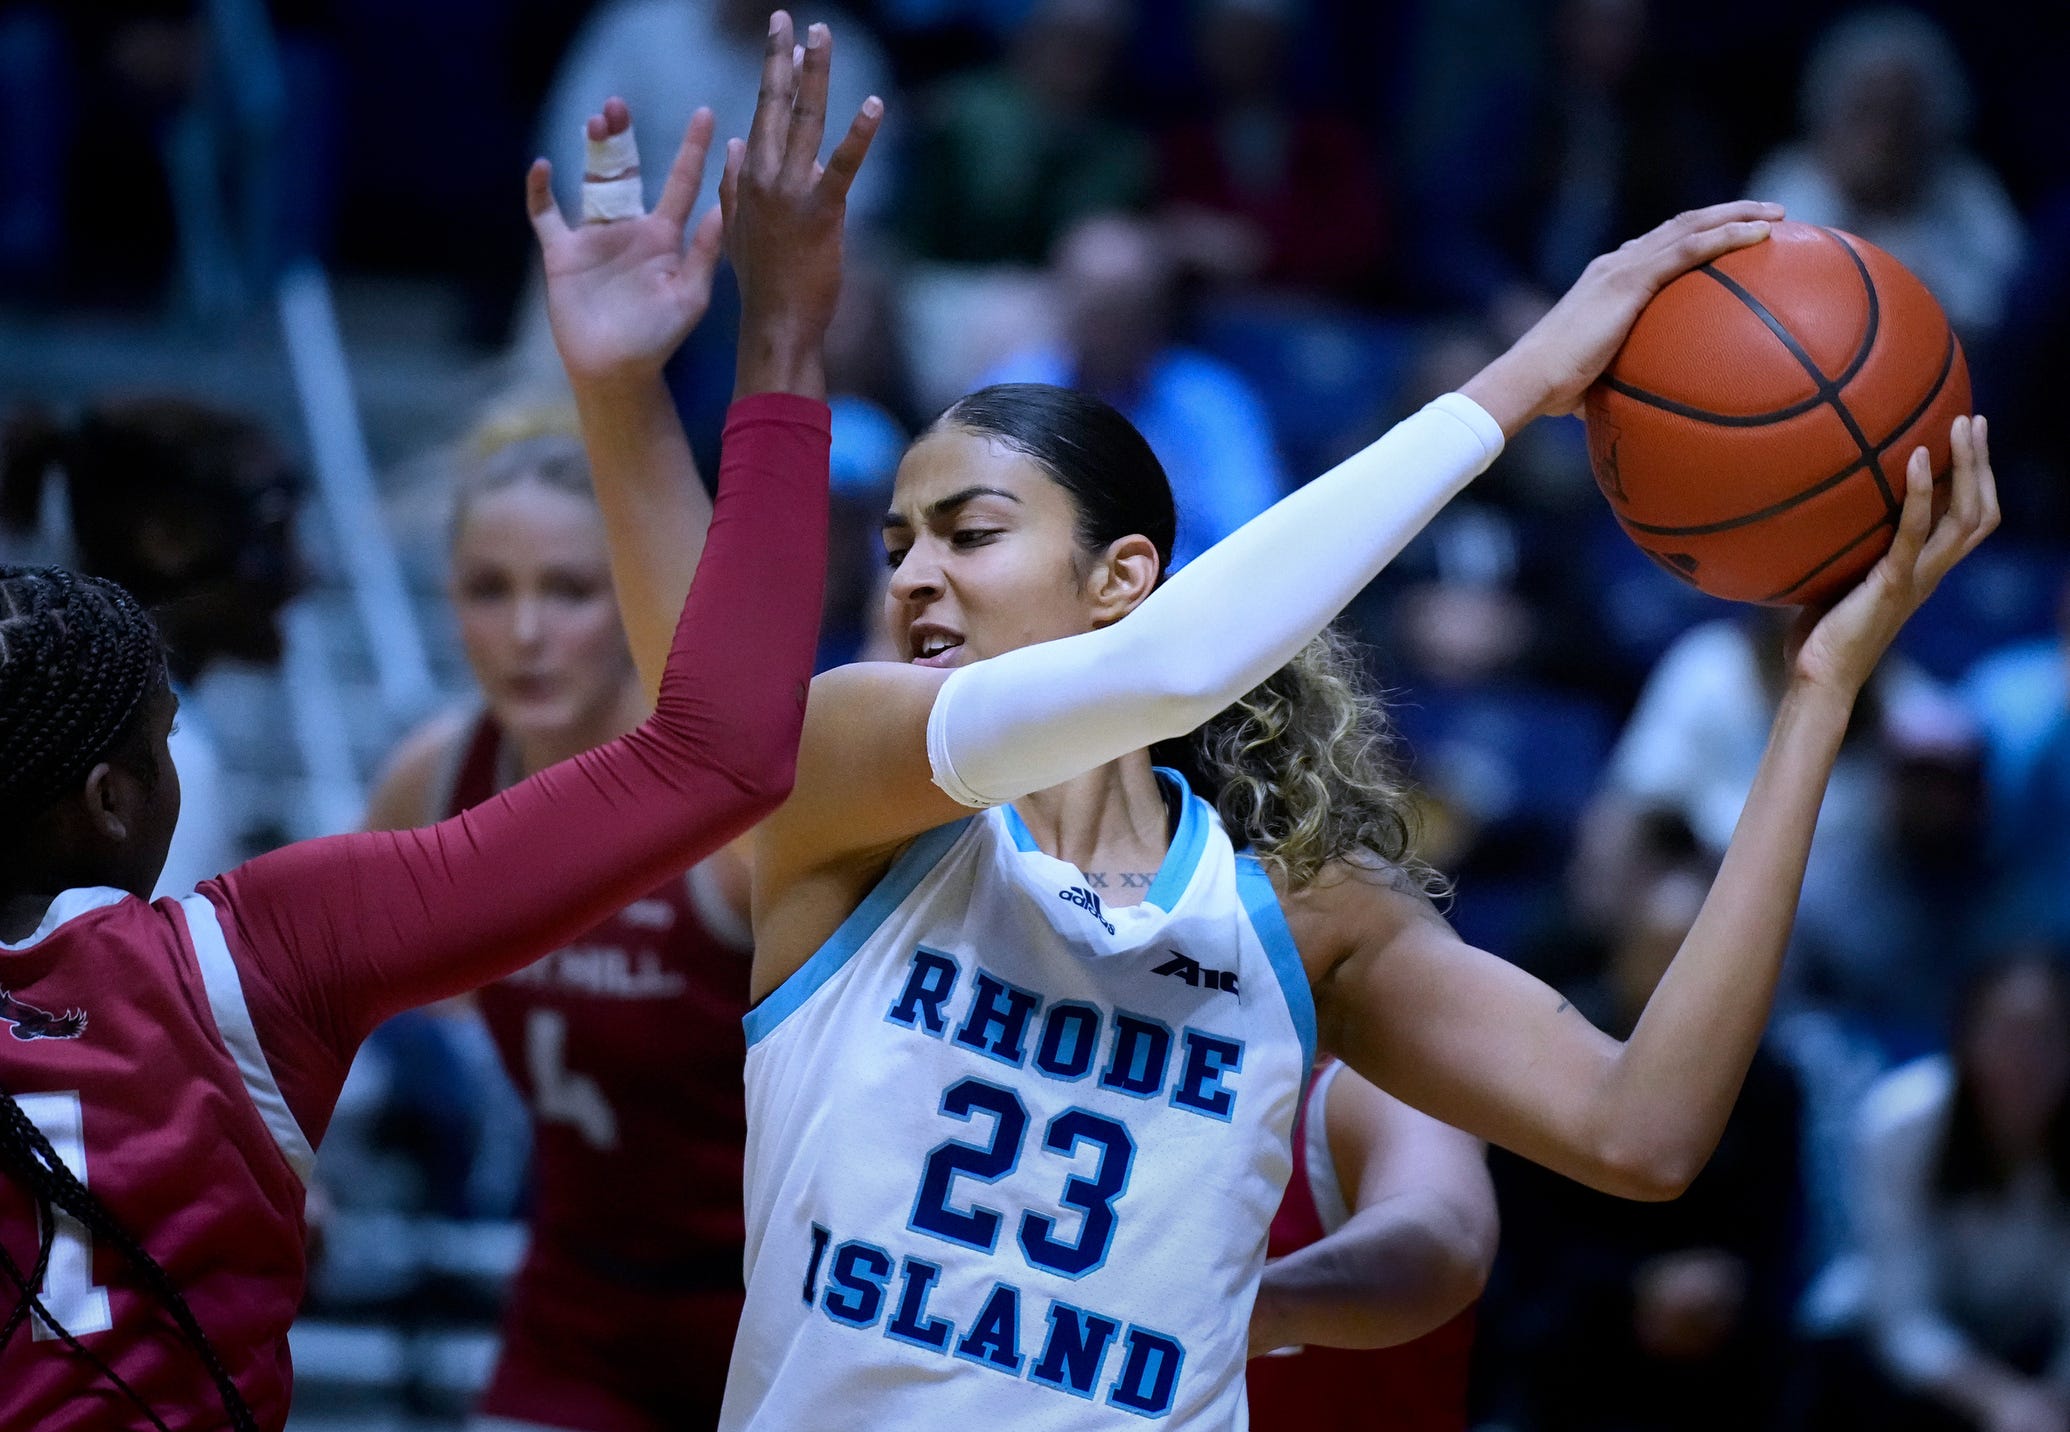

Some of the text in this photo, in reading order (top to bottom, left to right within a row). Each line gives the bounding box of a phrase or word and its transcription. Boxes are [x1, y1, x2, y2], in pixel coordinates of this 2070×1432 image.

[1058, 889, 1116, 936] adidas
[883, 945, 1245, 1123] RHODE
[906, 1074, 1137, 1281] 23
[802, 1220, 1186, 1419] ISLAND
